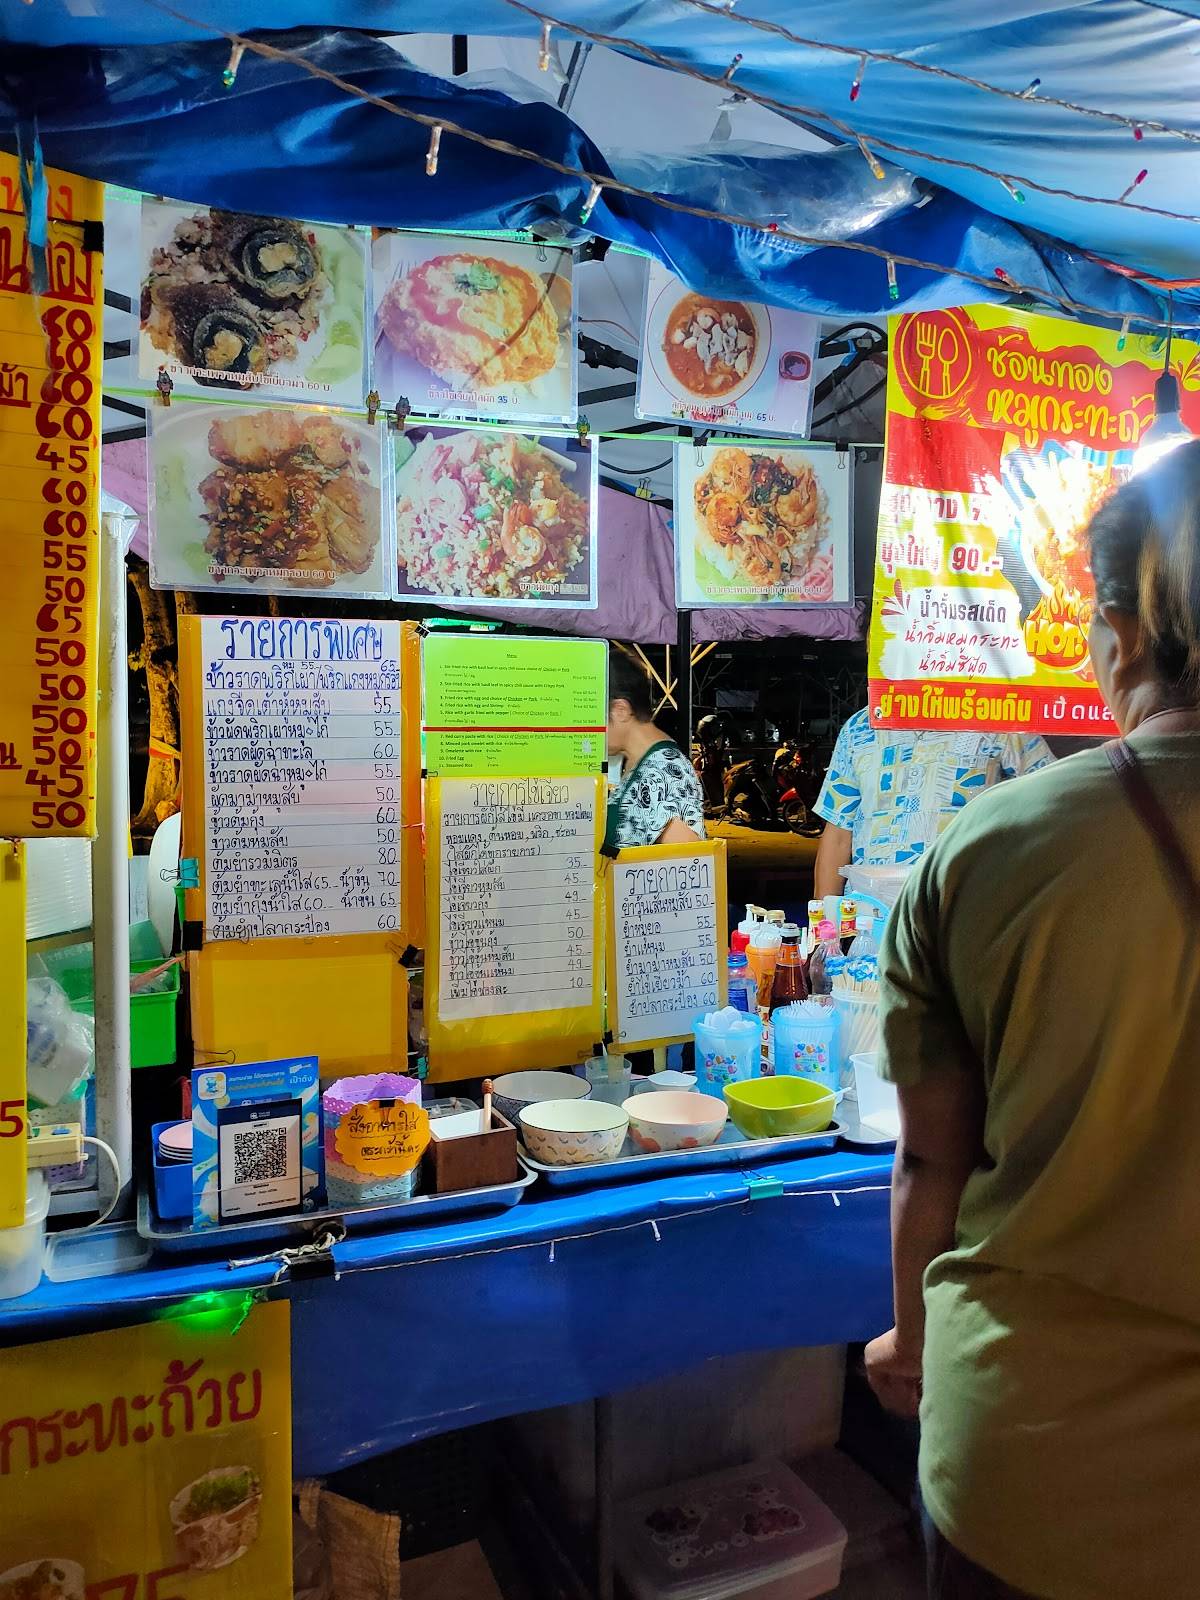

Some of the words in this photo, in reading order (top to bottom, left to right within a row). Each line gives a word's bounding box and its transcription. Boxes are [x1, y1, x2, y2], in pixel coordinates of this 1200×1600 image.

[987, 333, 1113, 395] ช้อนทอง
[35, 406, 93, 440] 60
[756, 412, 767, 422] 65
[36, 443, 90, 473] 45
[42, 478, 87, 505] 60
[43, 510, 87, 537] 60
[43, 540, 87, 572] 55
[45, 576, 85, 604] 50
[36, 604, 83, 633] 65
[36, 638, 86, 667] 50
[220, 619, 383, 660] รายการพิเศษ
[40, 673, 86, 701] 50
[880, 685, 1032, 722] ย่างให้พร้อมกิน
[1043, 695, 1115, 721] เปิดแล
[32, 704, 87, 735] 50
[33, 736, 82, 765] 50
[25, 764, 84, 798] 45
[32, 801, 85, 829] 50
[625, 858, 709, 895] รายการยำ
[0, 1358, 262, 1475] กระทะถ้วย
